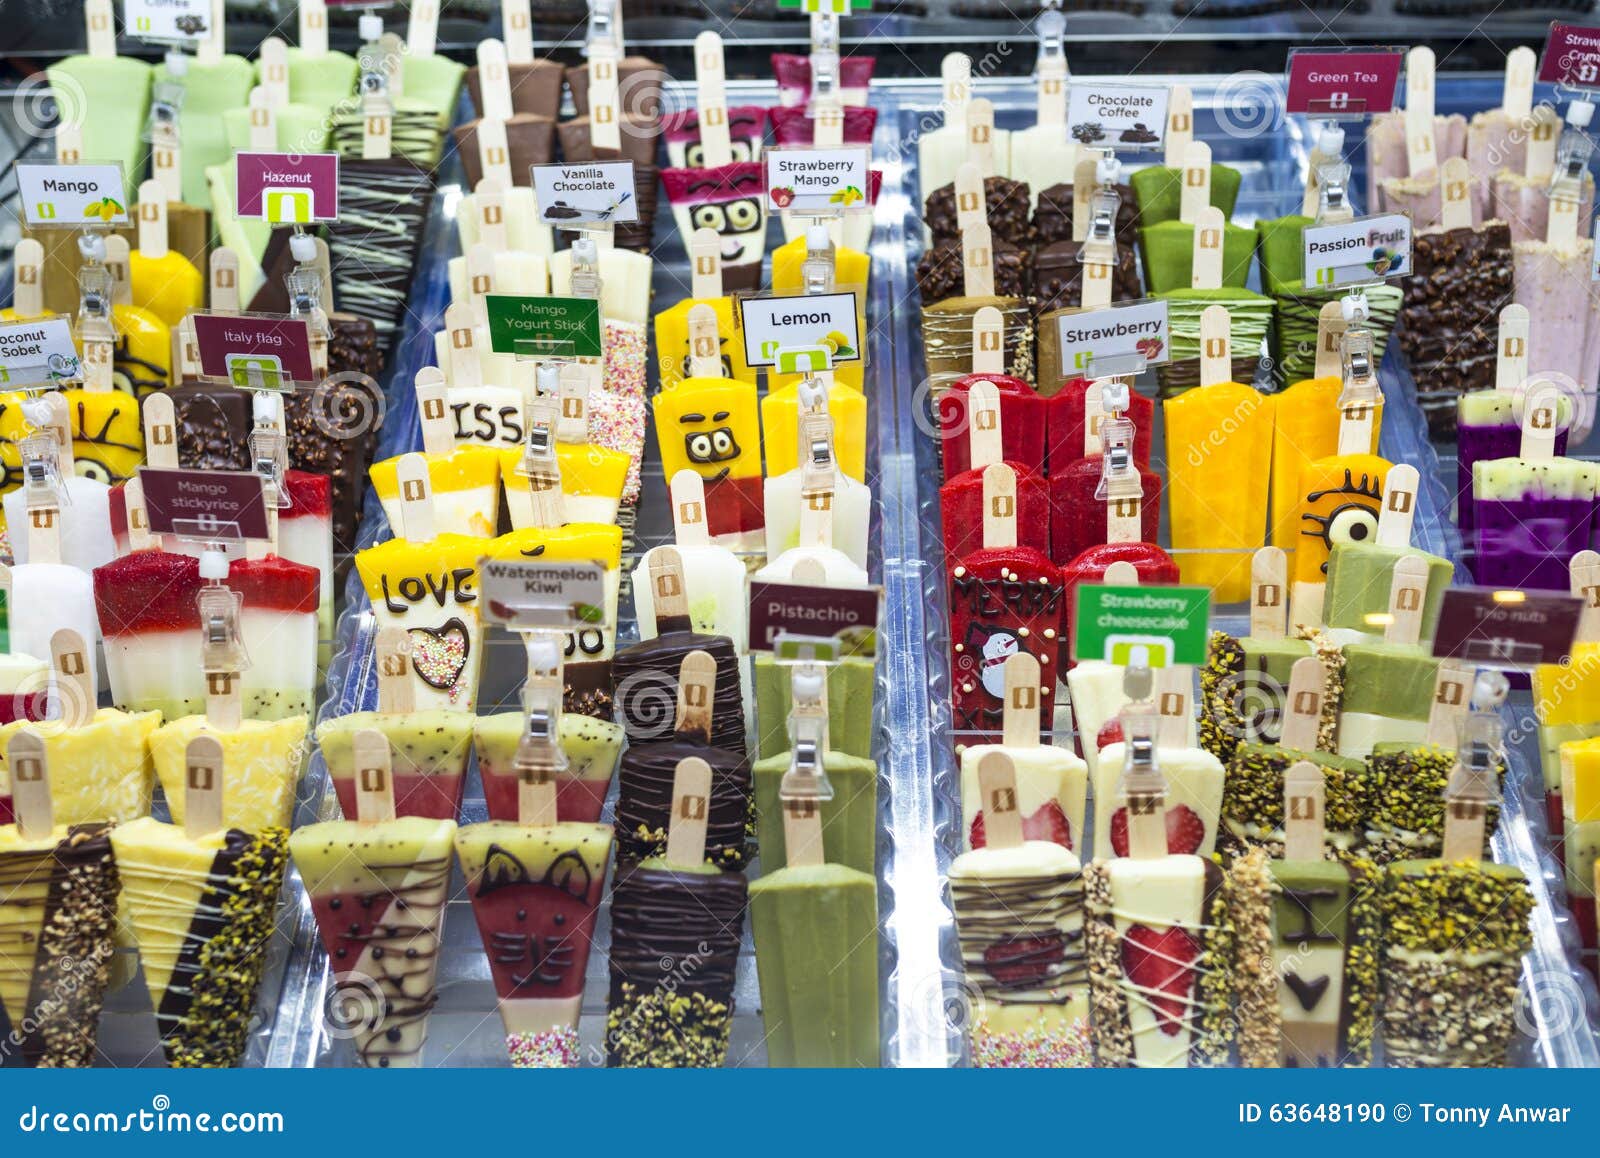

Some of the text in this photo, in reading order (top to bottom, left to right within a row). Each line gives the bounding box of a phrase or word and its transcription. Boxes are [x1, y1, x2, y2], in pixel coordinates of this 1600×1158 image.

[1307, 71, 1378, 84] Green Tea
[1087, 94, 1153, 107] Chocolate
[1098, 106, 1140, 118] Coffee
[561, 168, 604, 180] Vanilla
[778, 159, 854, 175] Strawberry
[262, 171, 312, 183] Hazenut
[794, 174, 840, 188] Mango
[43, 178, 98, 194] Mango
[553, 180, 615, 192] Chocolate
[1309, 227, 1406, 255] Passion Fruit
[521, 303, 567, 317] Mango
[505, 317, 586, 331] Yogurt Stick
[770, 309, 831, 327] Lemon
[1065, 319, 1163, 343] Strawberry
[224, 331, 282, 346] Italy flag
[1, 344, 43, 358] Sobet
[178, 480, 228, 495] Mango
[171, 497, 239, 511] stickyrice
[486, 565, 599, 581] Watermelon
[381, 568, 477, 614] LOVE
[524, 580, 563, 594] Kiwi
[1100, 592, 1189, 613] Strawberry
[767, 602, 859, 622] Pistachio
[1097, 611, 1190, 630] cheesecake
